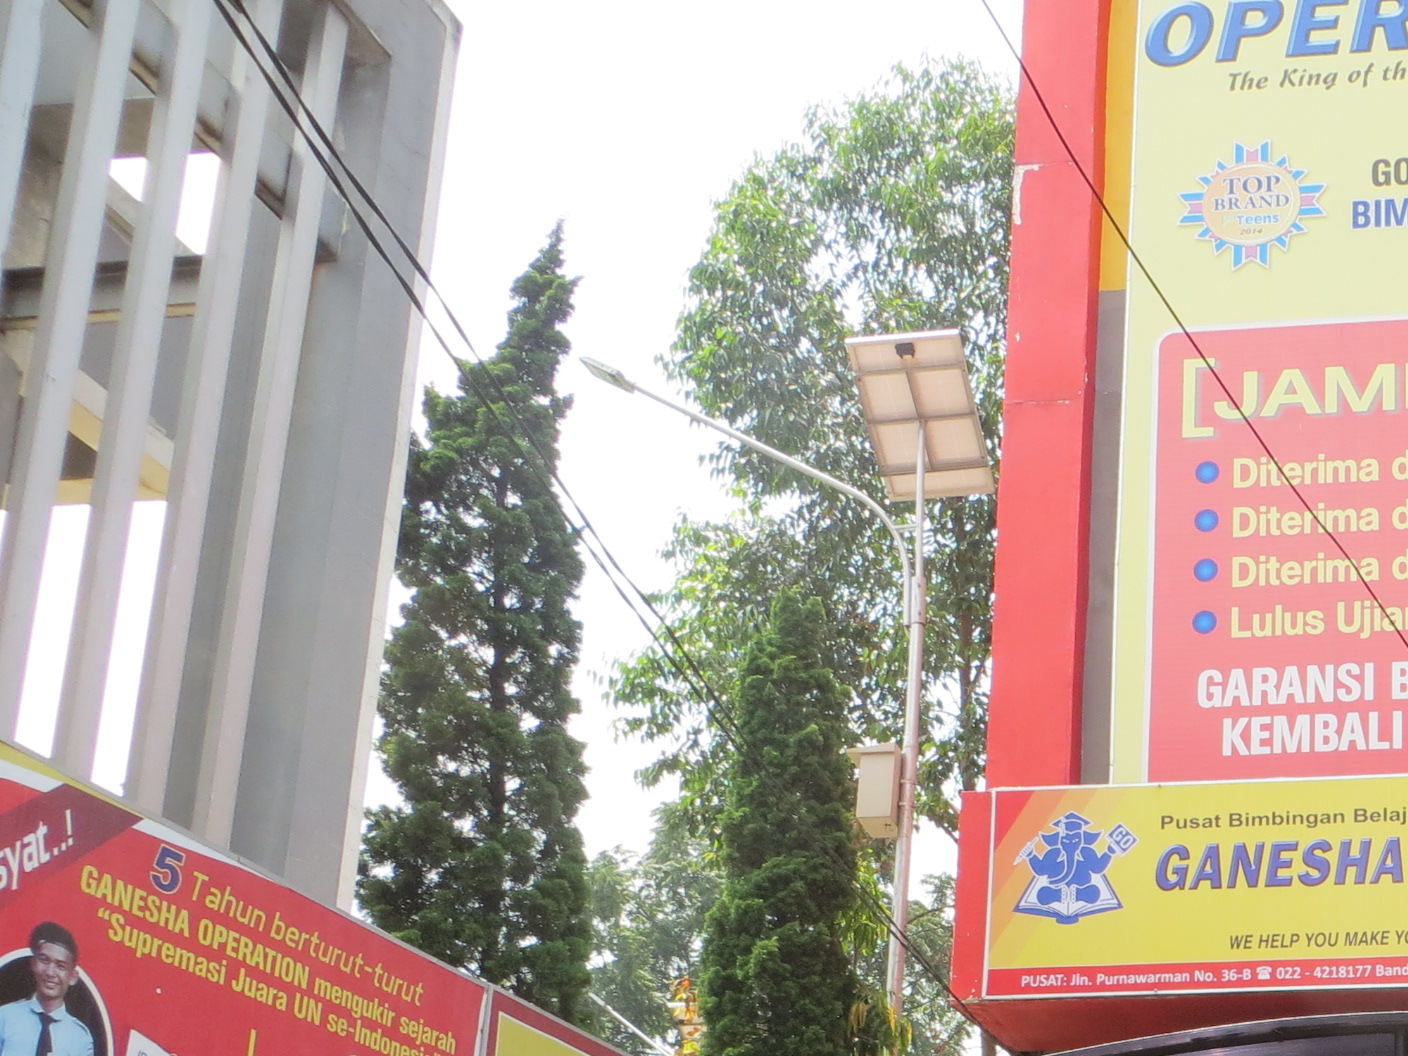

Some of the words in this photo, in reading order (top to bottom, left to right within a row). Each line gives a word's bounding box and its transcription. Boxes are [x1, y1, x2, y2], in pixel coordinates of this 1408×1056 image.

[1228, 71, 1268, 92] The
[1279, 67, 1337, 91] King
[1348, 63, 1375, 88] of
[1222, 175, 1281, 195] TOP
[1213, 194, 1290, 211] BRAND
[1232, 453, 1380, 488] Diterima
[1232, 503, 1380, 537] Diterima
[1231, 553, 1380, 587] Diterima
[1230, 604, 1325, 638] Lulus
[1197, 662, 1374, 708] GARANSI
[1222, 711, 1402, 756] KEMBALI
[1160, 813, 1221, 830] Pusat
[1228, 810, 1345, 829] Bimbingan
[1112, 827, 1134, 849] GO
[1155, 836, 1404, 891] GANESHA
[150, 843, 186, 894] 5
[192, 871, 266, 932] Tahun
[270, 912, 424, 1006] berturut-turut
[1229, 935, 1253, 950] WE
[1258, 933, 1300, 949] HELP
[1305, 932, 1339, 948] YOU
[1344, 931, 1390, 947] MAKE
[80, 865, 190, 938] GANESHA
[198, 918, 310, 990] OPERATION
[314, 977, 396, 1028] mengukir
[400, 1016, 456, 1055] sejarah
[1021, 974, 1067, 988] PUSAT:
[1070, 973, 1092, 987] Jln.
[1096, 971, 1191, 985] Purnawarman
[1194, 970, 1217, 983] No.
[1221, 969, 1251, 982] 36-B
[1276, 967, 1301, 980] 022
[1313, 964, 1371, 979] 4218177
[231, 967, 288, 1012] Juara
[294, 992, 323, 1026] UN
